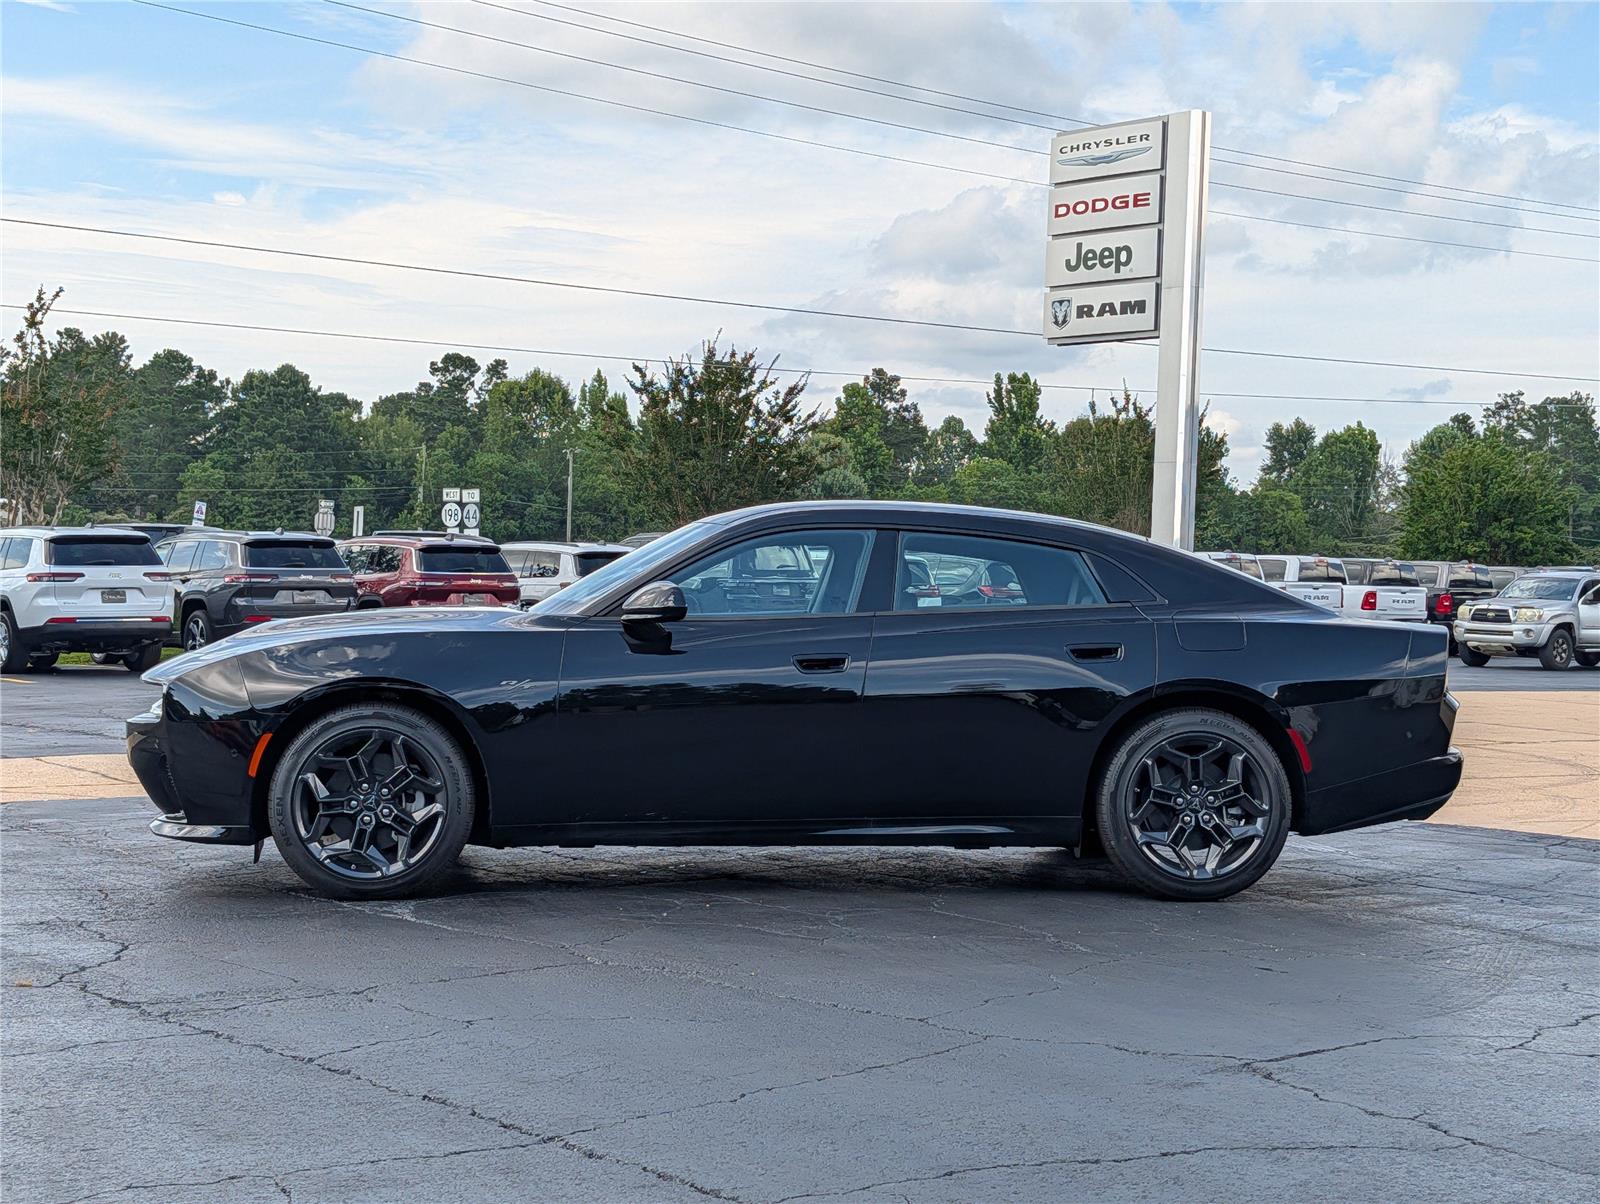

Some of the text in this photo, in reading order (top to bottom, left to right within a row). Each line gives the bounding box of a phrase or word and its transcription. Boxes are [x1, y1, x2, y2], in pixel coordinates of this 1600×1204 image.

[1059, 133, 1151, 154] CHRYSLER
[1054, 192, 1151, 219] DODGE
[1065, 242, 1133, 274] Jeep
[1076, 299, 1147, 319] RAM
[445, 491, 458, 499] WEST
[467, 492, 475, 500] TO
[444, 508, 459, 522] 198
[465, 509, 478, 523] 44
[275, 796, 293, 847] NEXEN
